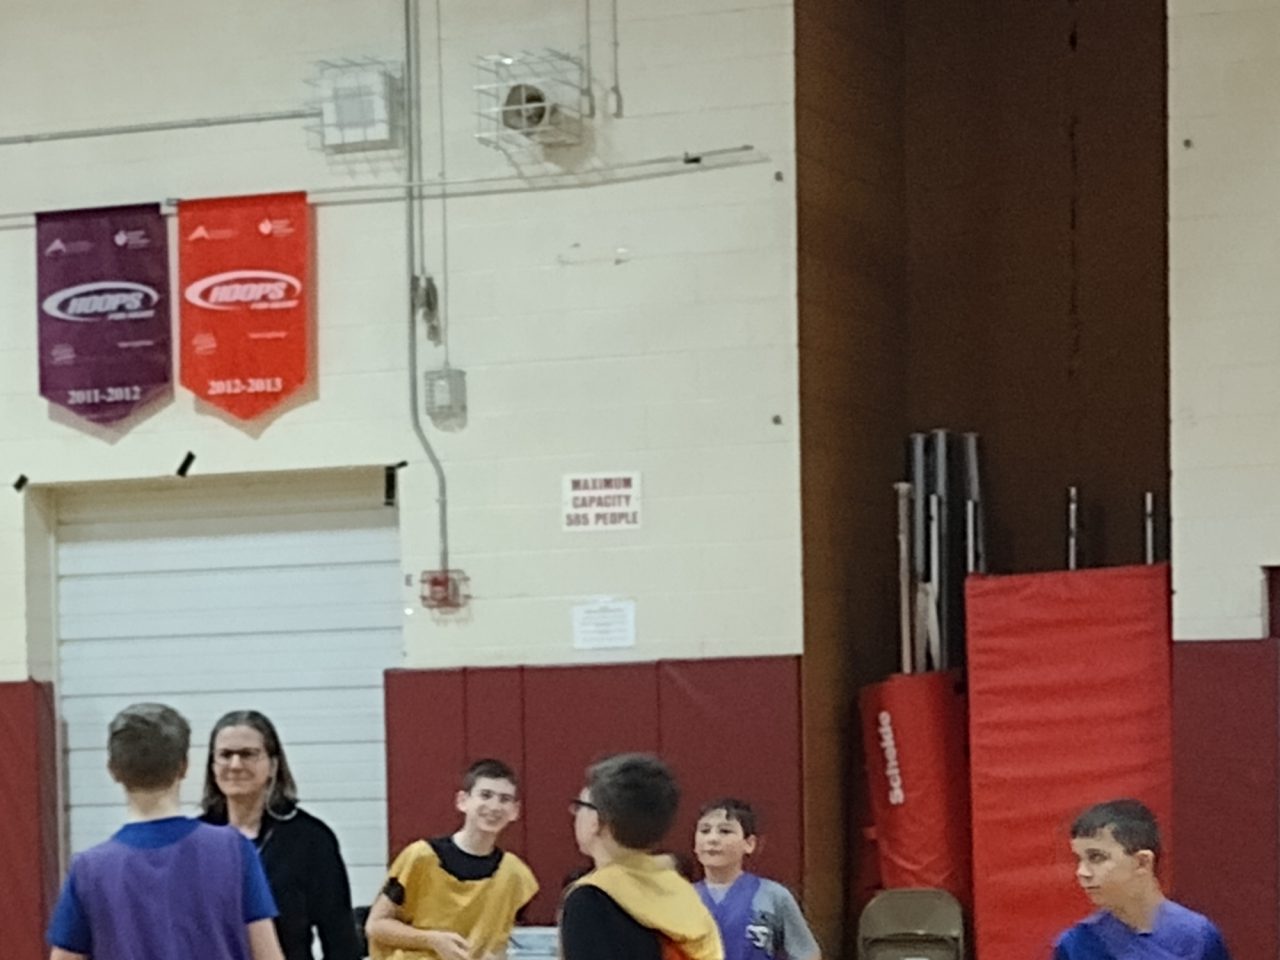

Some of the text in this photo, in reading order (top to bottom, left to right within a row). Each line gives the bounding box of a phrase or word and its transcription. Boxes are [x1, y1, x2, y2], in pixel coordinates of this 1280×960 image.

[209, 283, 287, 303] HOOPS
[68, 292, 143, 314] HOOPS
[571, 477, 632, 491] MAXIMUM
[572, 494, 632, 509] CAPACITY
[594, 511, 638, 525] PEOPLE
